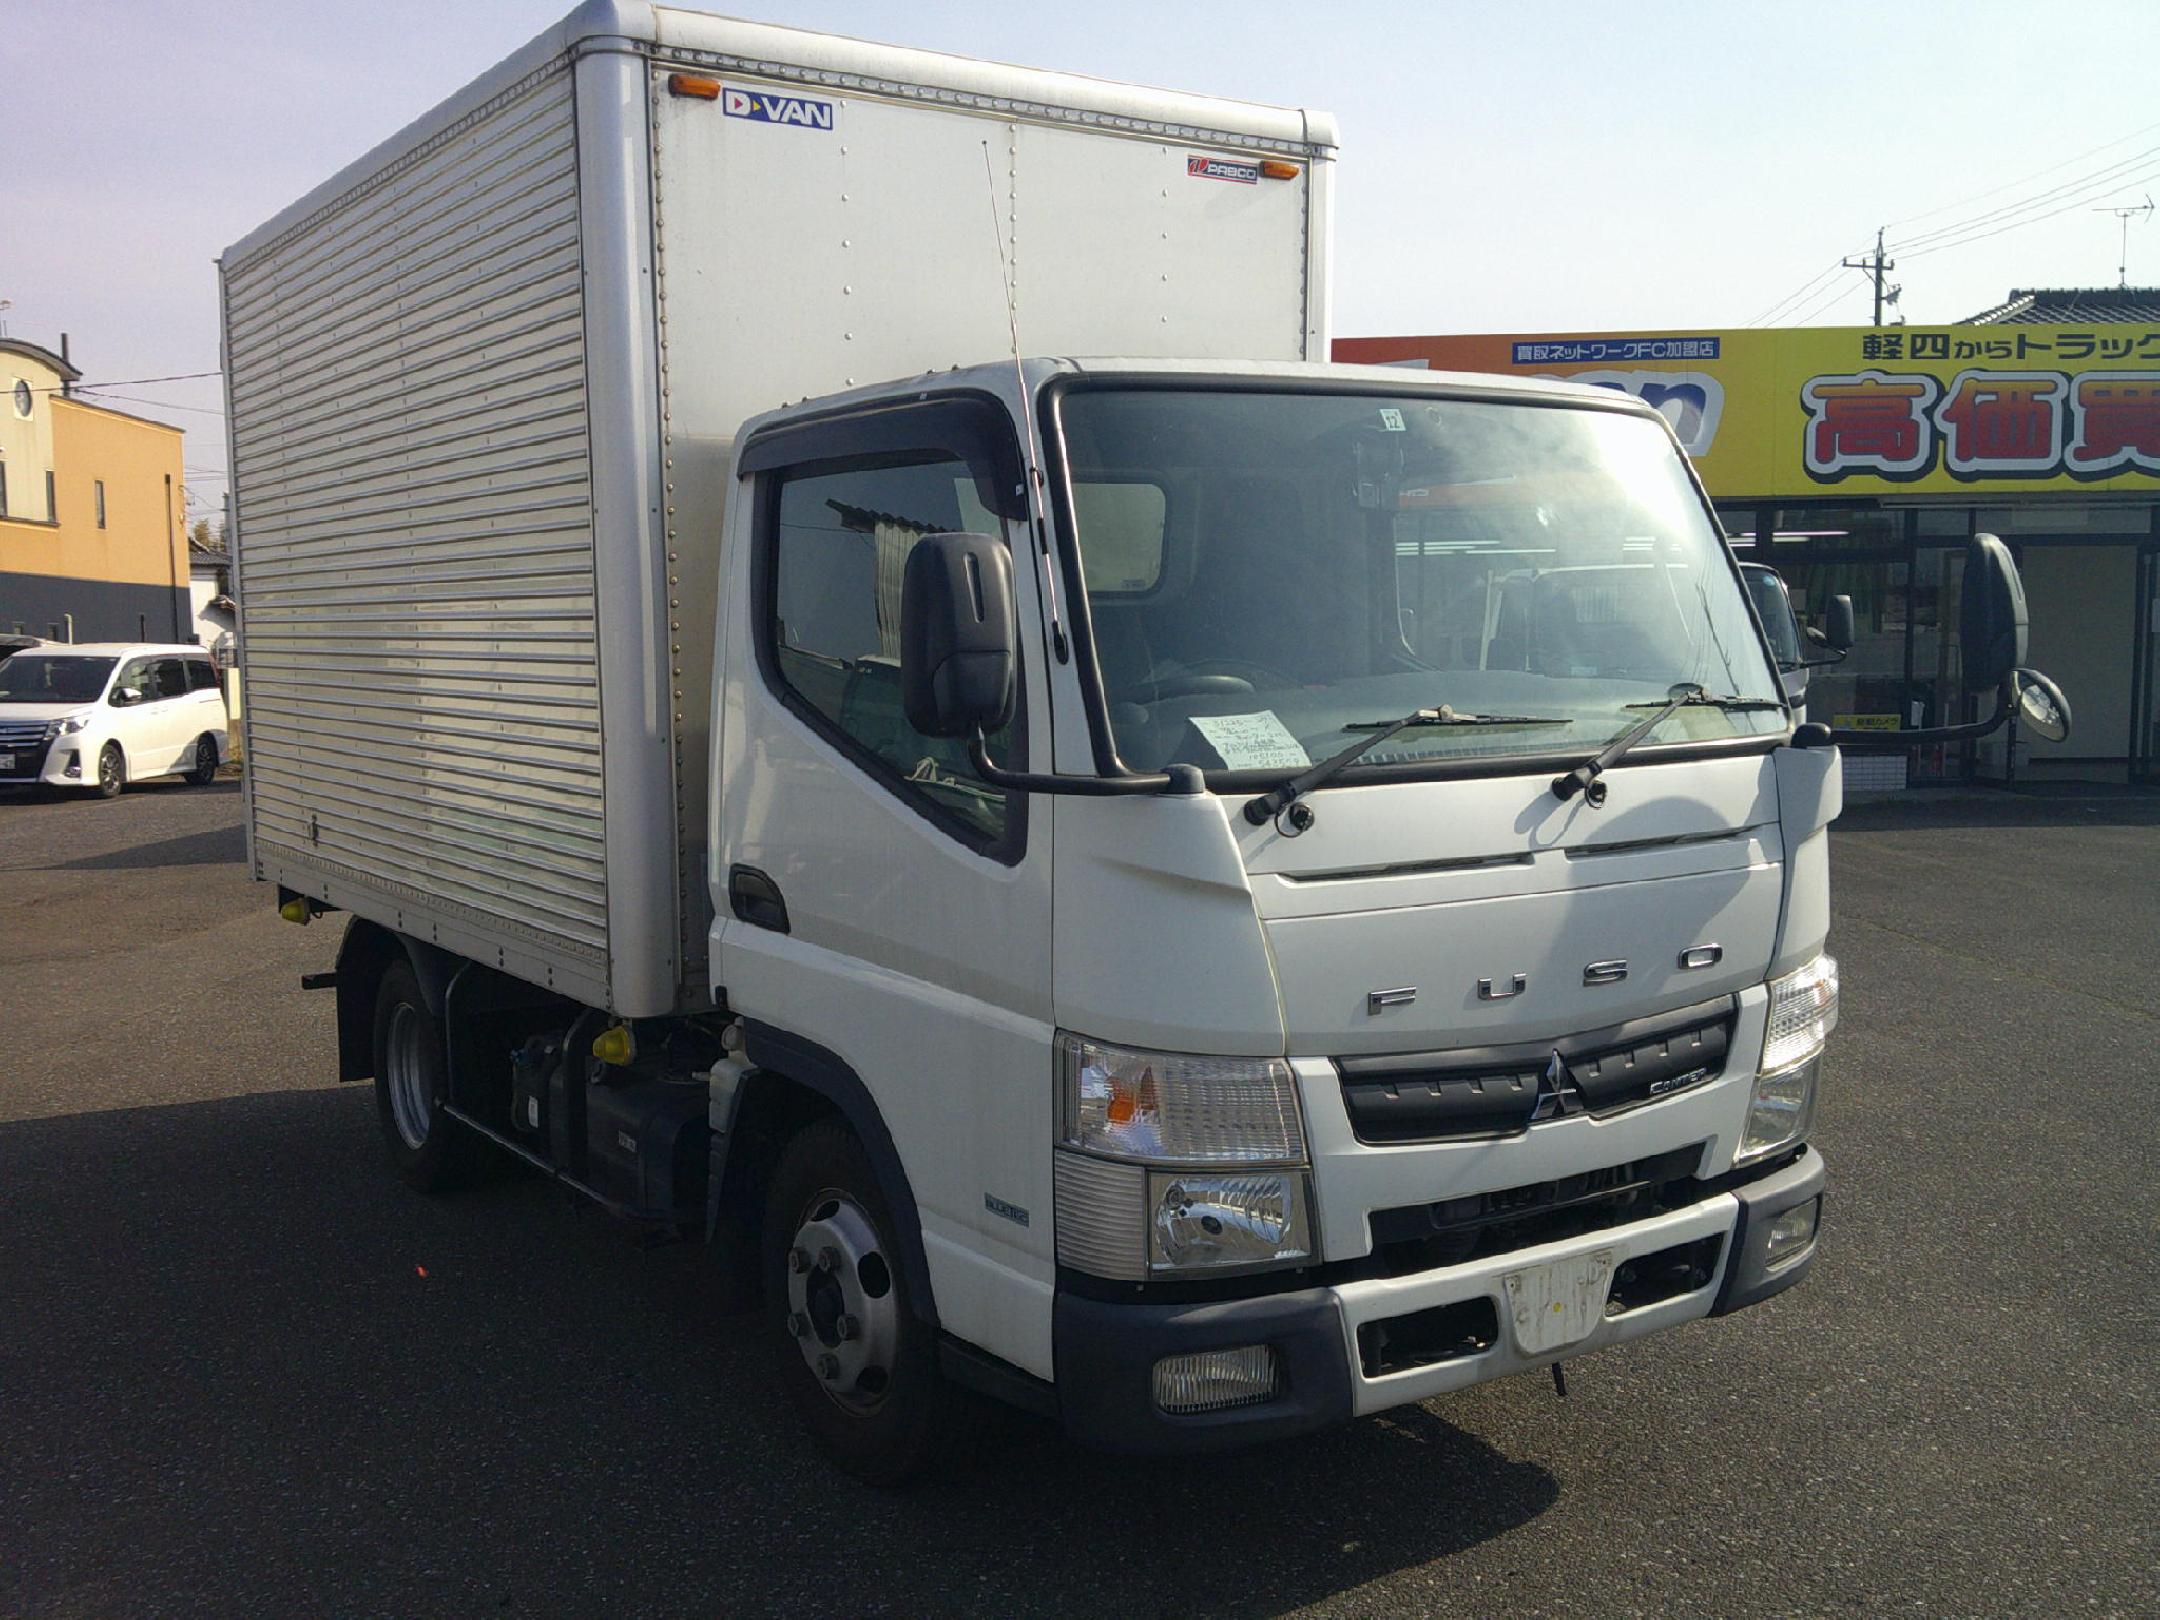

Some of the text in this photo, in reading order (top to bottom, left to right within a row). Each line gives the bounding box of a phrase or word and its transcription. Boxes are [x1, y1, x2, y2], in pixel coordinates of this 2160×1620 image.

[1207, 164, 1256, 179] PABCO
[1517, 341, 1714, 361] 買取ネットワークFC加盟店
[1862, 334, 2160, 360] 軽四からトラック
[1368, 942, 1723, 1016] FUSO
